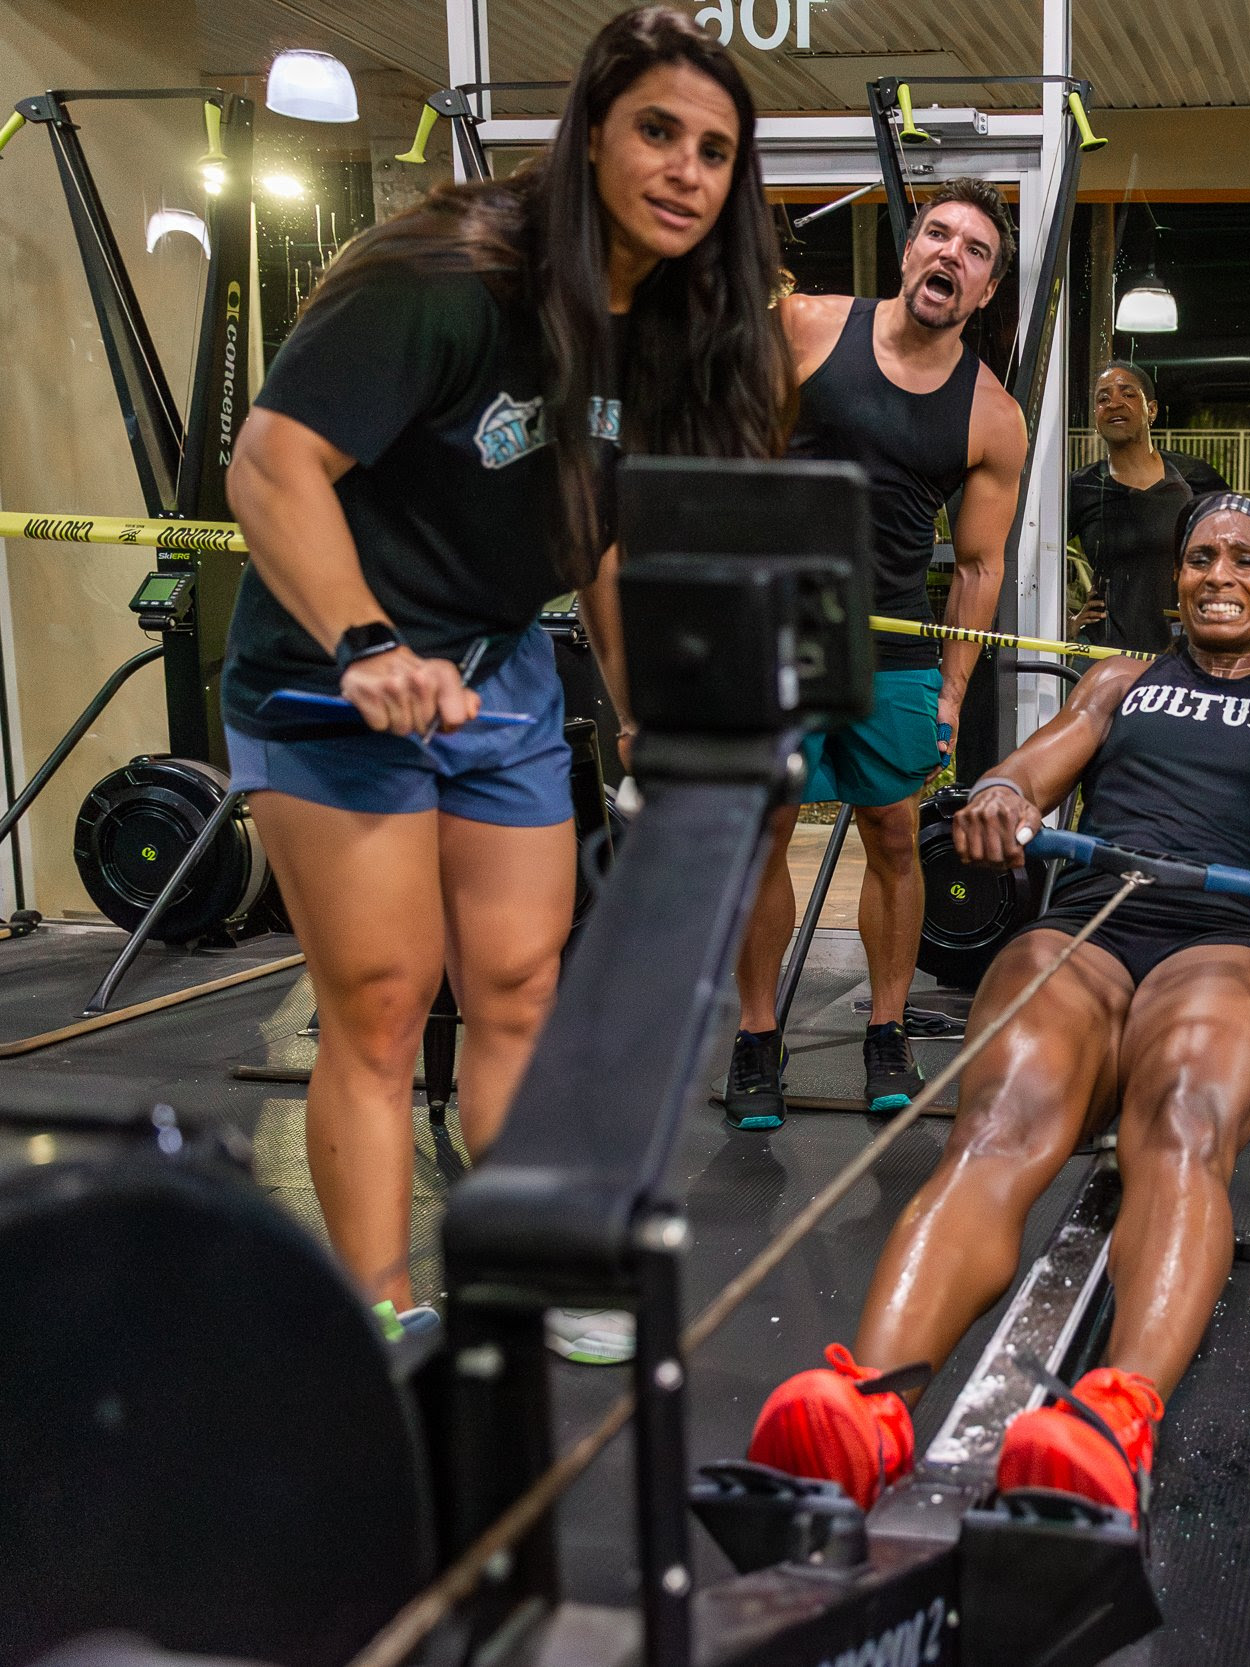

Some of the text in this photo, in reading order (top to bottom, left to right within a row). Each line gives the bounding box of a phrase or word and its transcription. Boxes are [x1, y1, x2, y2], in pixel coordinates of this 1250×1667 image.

[218, 323, 238, 466] concept 2
[24, 518, 94, 542] CAUTION
[157, 526, 235, 550] CUIDADO
[158, 552, 190, 560] SkiERG
[141, 846, 156, 861] C2
[950, 884, 966, 899] C2
